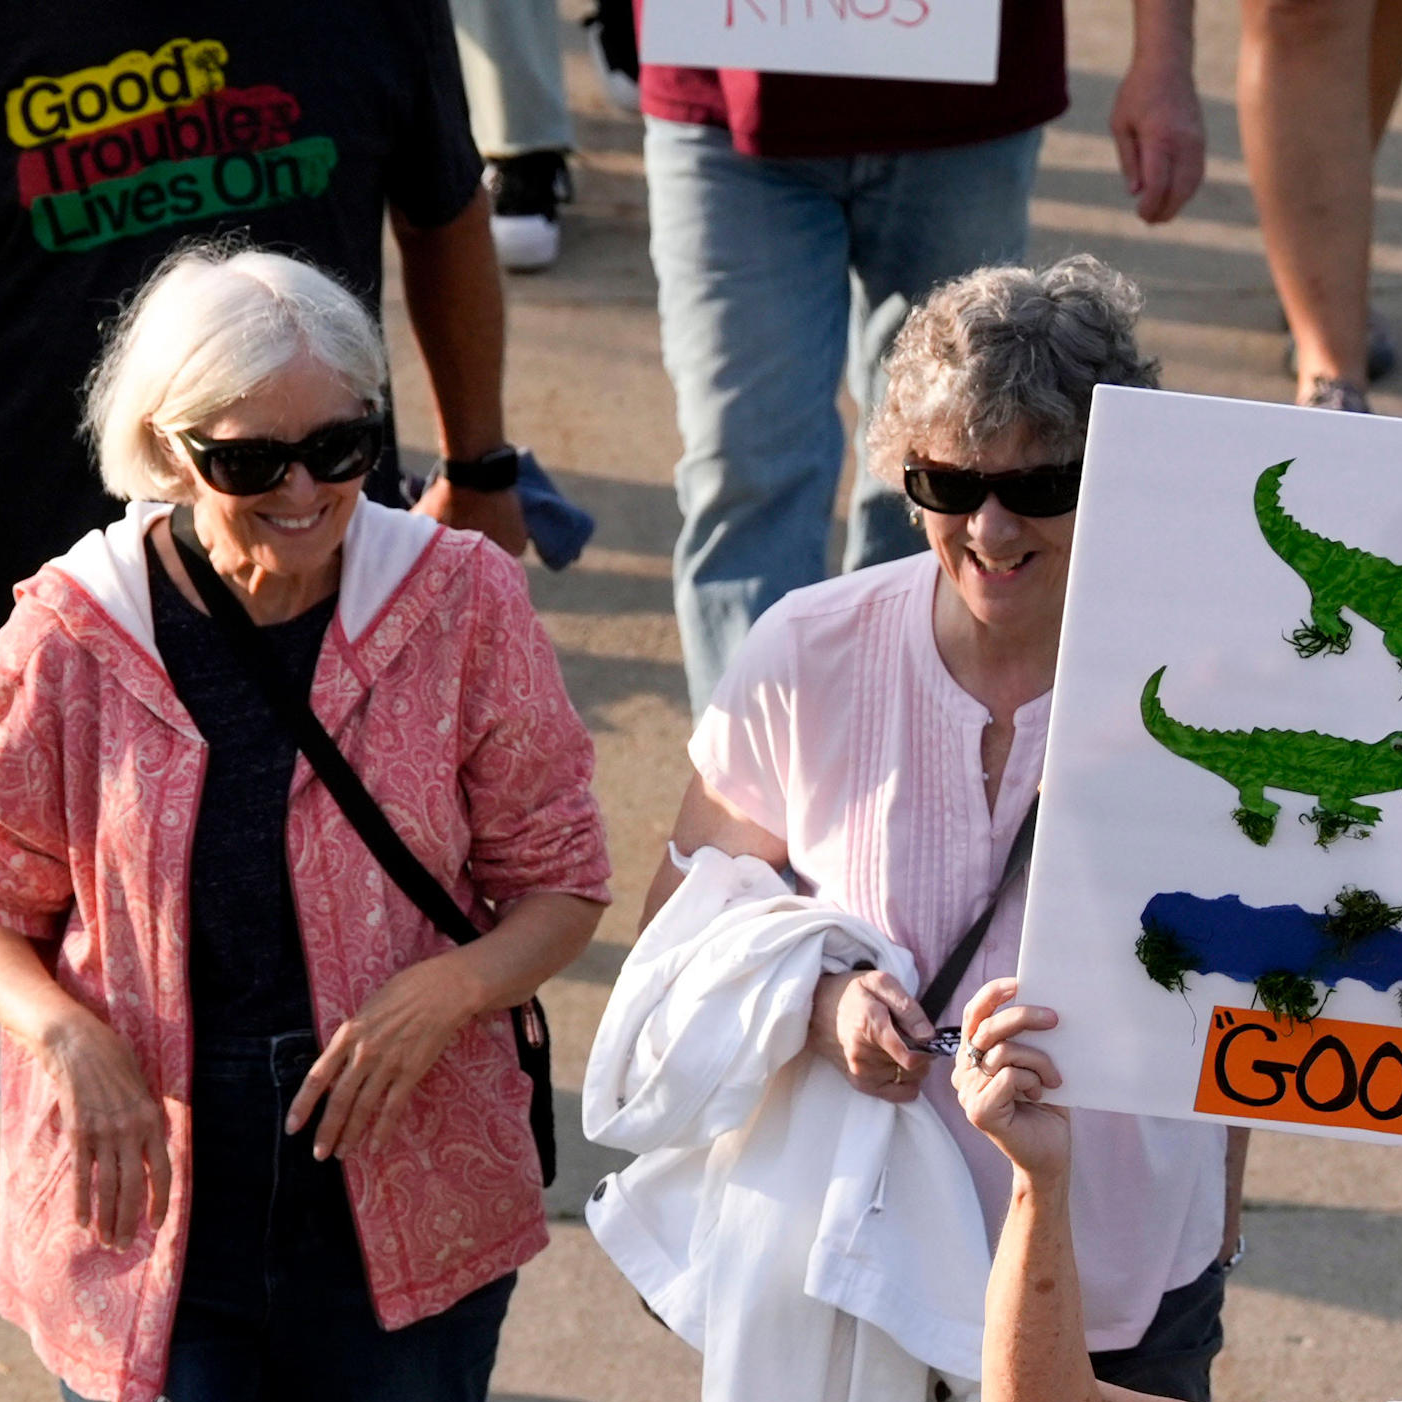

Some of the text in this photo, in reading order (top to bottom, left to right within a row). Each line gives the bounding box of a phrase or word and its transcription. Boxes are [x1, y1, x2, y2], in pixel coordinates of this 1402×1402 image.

[20, 46, 191, 137] Good
[30, 94, 261, 193] Trouble
[41, 152, 305, 247] Lives On
